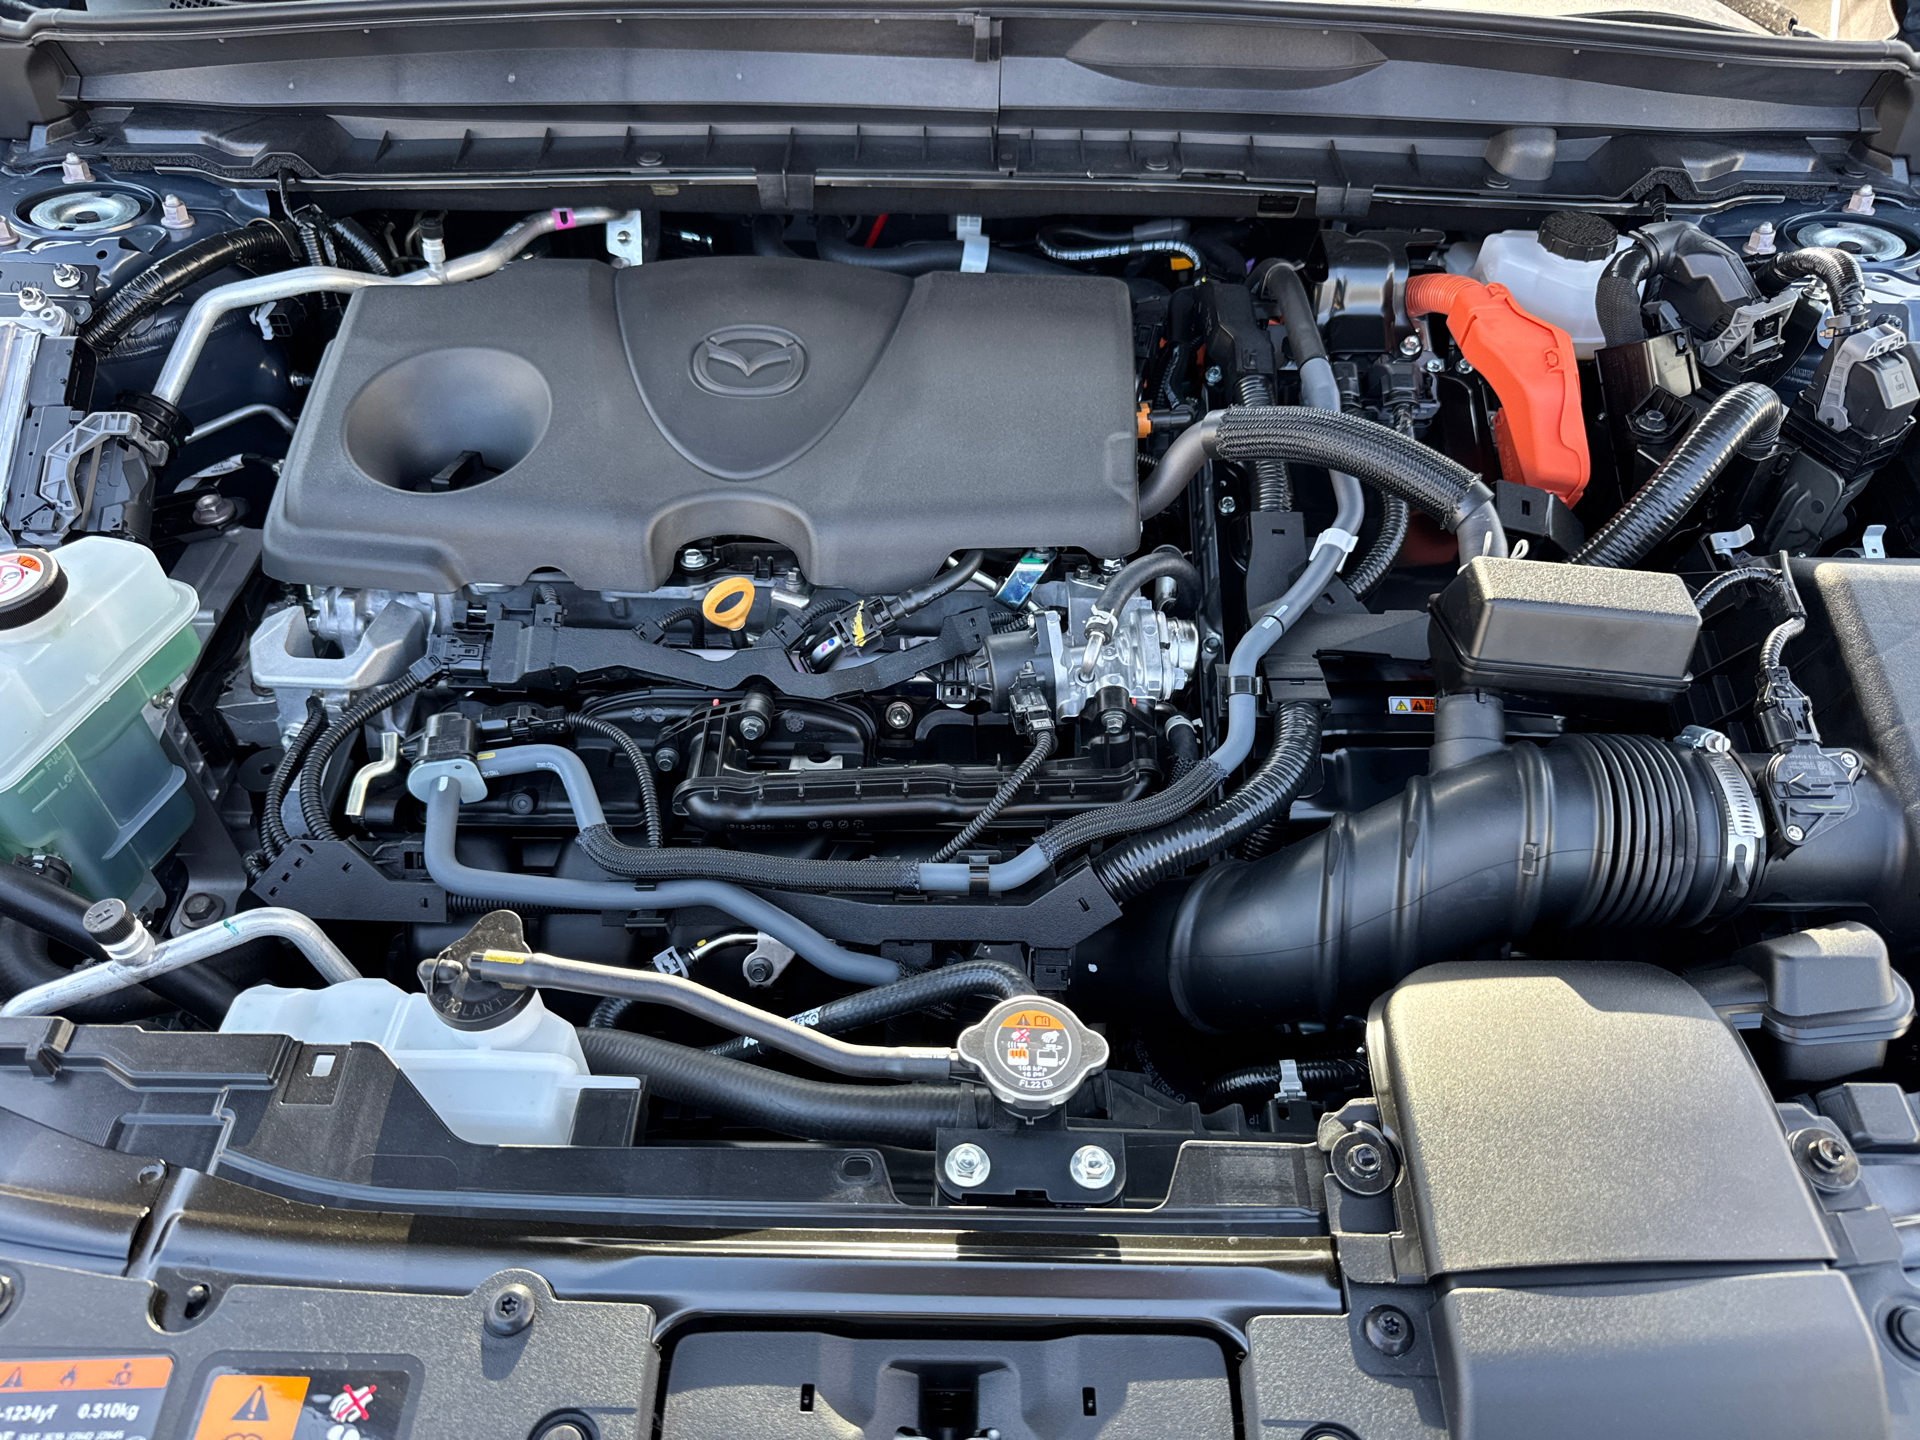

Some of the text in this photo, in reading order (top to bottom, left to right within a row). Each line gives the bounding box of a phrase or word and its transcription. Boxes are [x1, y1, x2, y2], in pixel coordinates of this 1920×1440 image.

[44, 747, 67, 771] FULL
[57, 766, 77, 790] LOW
[436, 993, 504, 1016] COOLANT
[1032, 1065, 1048, 1073] kPa
[1019, 1079, 1042, 1089] FL22
[77, 1402, 140, 1421] 0.510kg
